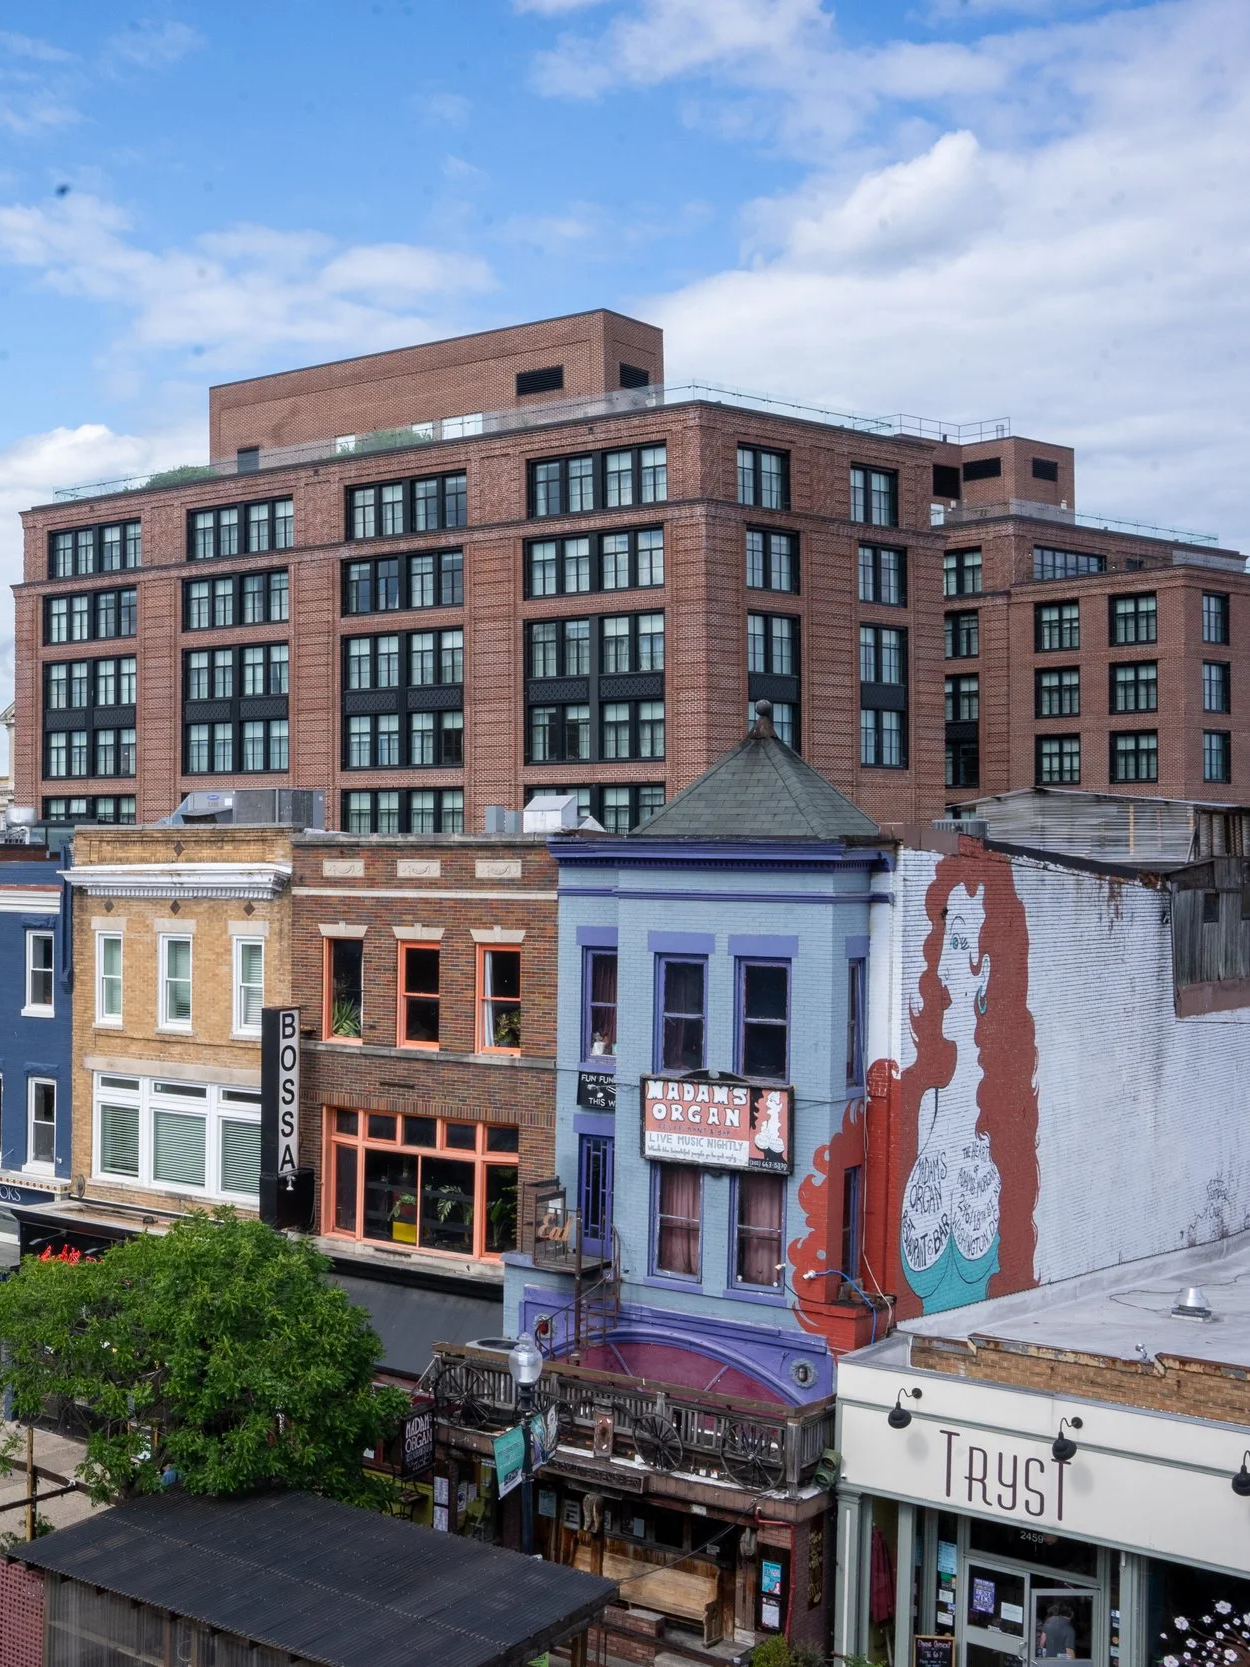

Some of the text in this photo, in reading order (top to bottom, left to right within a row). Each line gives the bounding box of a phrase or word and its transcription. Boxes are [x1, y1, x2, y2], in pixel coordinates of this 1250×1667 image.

[581, 1074, 597, 1082] FUN
[280, 1012, 298, 1172] BOSSA
[588, 1097, 605, 1107] THIS
[646, 1080, 748, 1105] MADAM'S
[652, 1102, 741, 1127] ORGAN
[650, 1132, 744, 1151] LIVE MUSIC NIGHTLY
[910, 1180, 943, 1214] ORGAN
[933, 1213, 950, 1255] BAR
[405, 1429, 433, 1453] ORGAN
[940, 1429, 1072, 1522] TRYST
[1020, 1530, 1044, 1544] 2459
